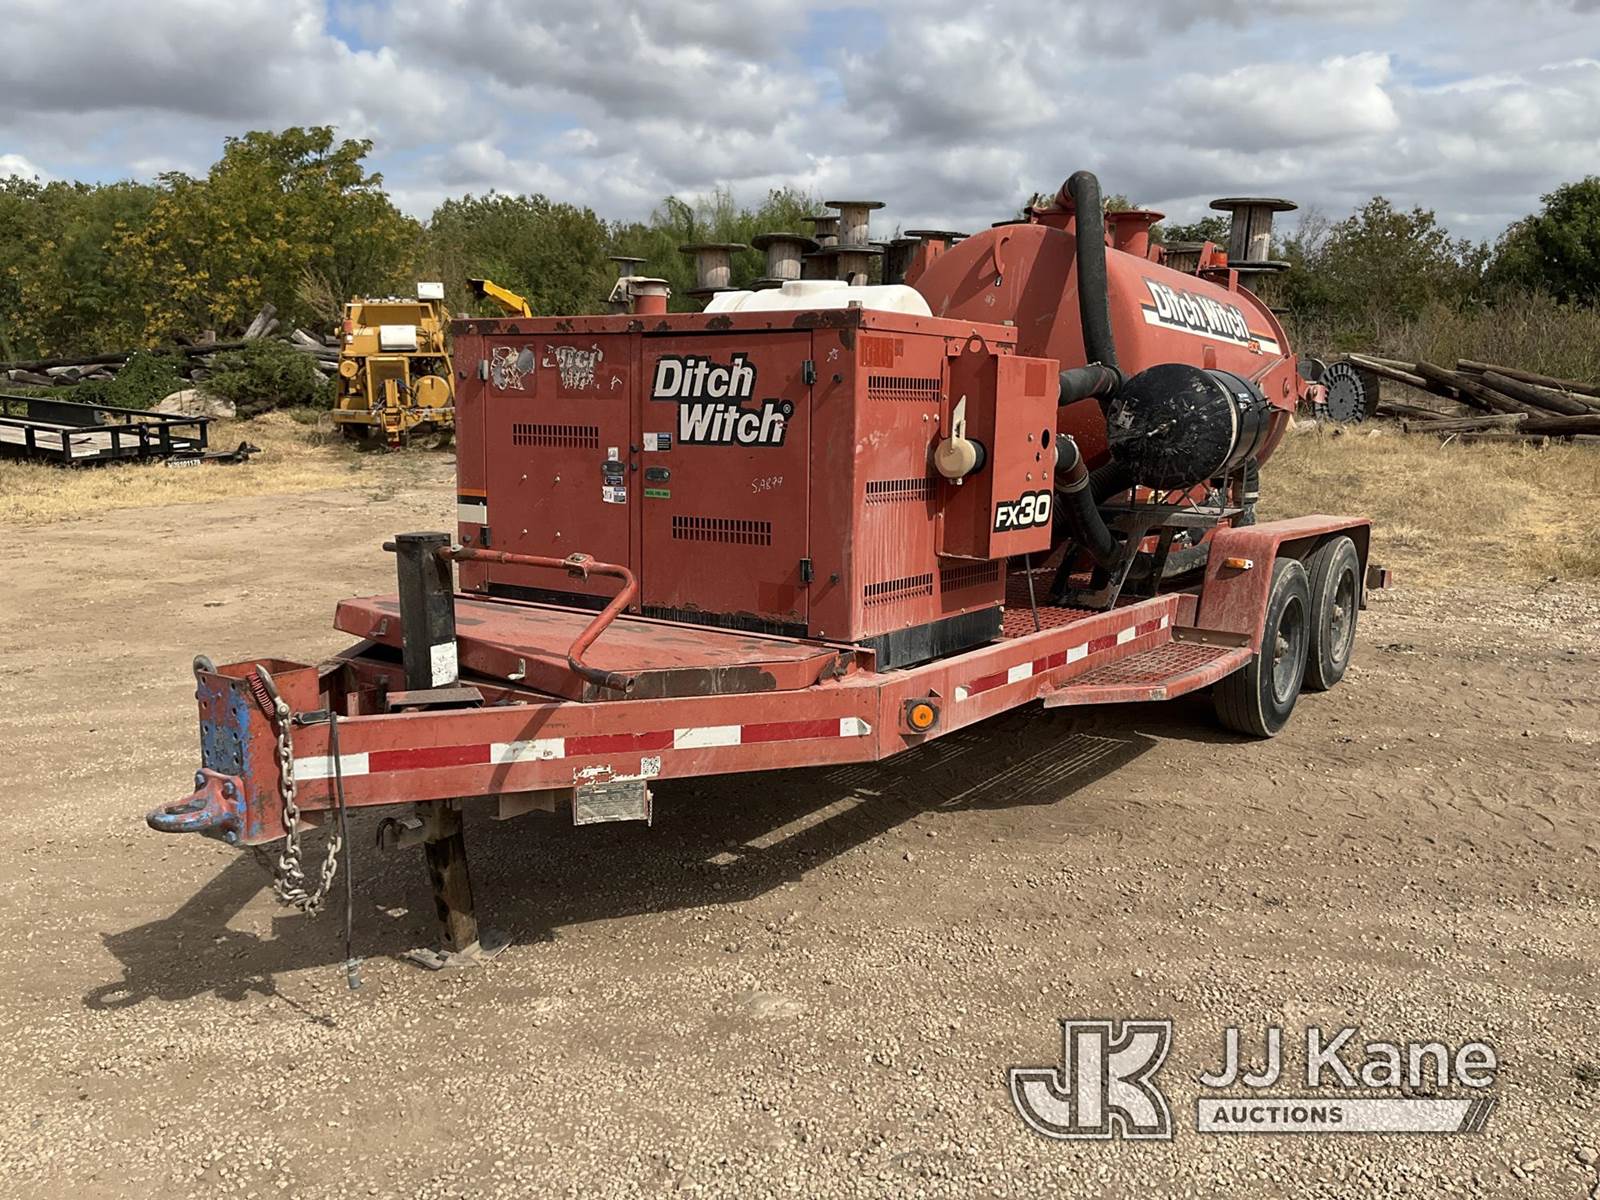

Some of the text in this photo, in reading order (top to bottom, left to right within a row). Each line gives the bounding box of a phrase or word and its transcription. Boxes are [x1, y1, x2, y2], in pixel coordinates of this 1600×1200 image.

[1145, 280, 1250, 339] Ditch Witch
[653, 357, 754, 398] Ditch
[995, 494, 1051, 528] FX30
